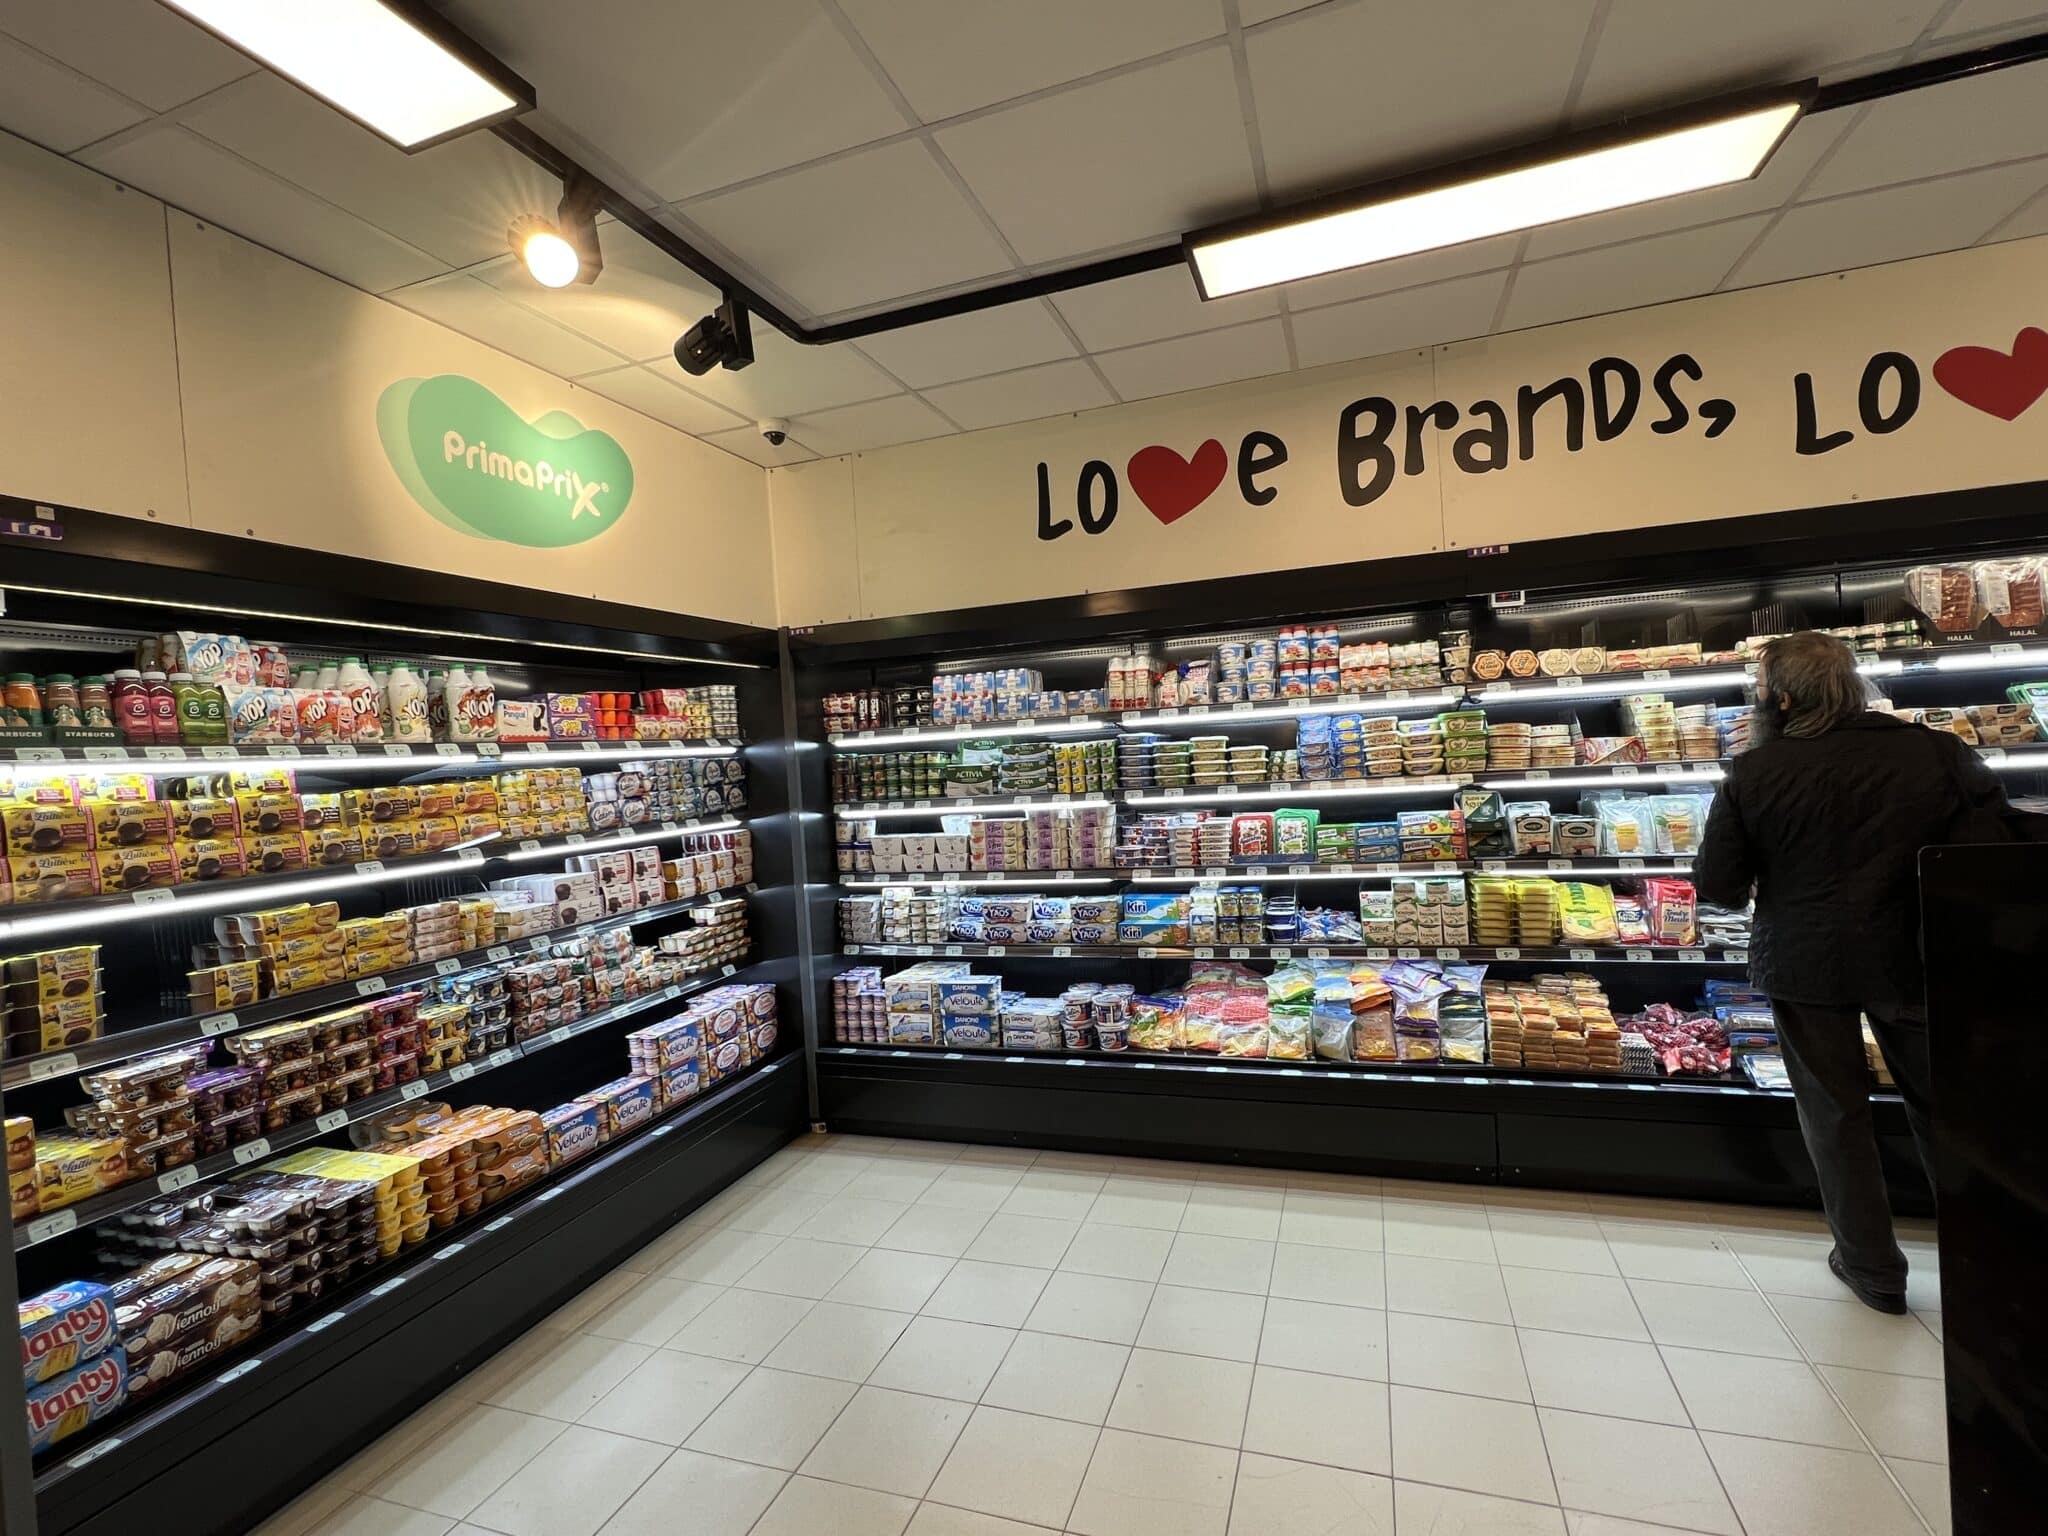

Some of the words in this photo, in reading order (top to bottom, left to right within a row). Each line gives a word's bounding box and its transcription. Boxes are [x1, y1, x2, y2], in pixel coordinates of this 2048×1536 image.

[352, 685, 372, 715] OP
[240, 695, 267, 723] YOP
[305, 696, 328, 723] YOP
[955, 770, 983, 779] ACTIVIA
[988, 906, 1011, 917] YAOS
[1039, 903, 1062, 913] YAOS
[1076, 906, 1100, 917] YAOS
[1127, 901, 1147, 914] Kiri
[956, 925, 976, 936] YAOS
[989, 929, 1011, 939] YAOS
[1033, 928, 1056, 938] YAOS
[1076, 929, 1100, 939] YAOS
[1121, 928, 1142, 940] Kiri
[560, 1115, 584, 1131] DANONE
[556, 1124, 593, 1151] Velouté
[19, 1298, 109, 1365] lanby
